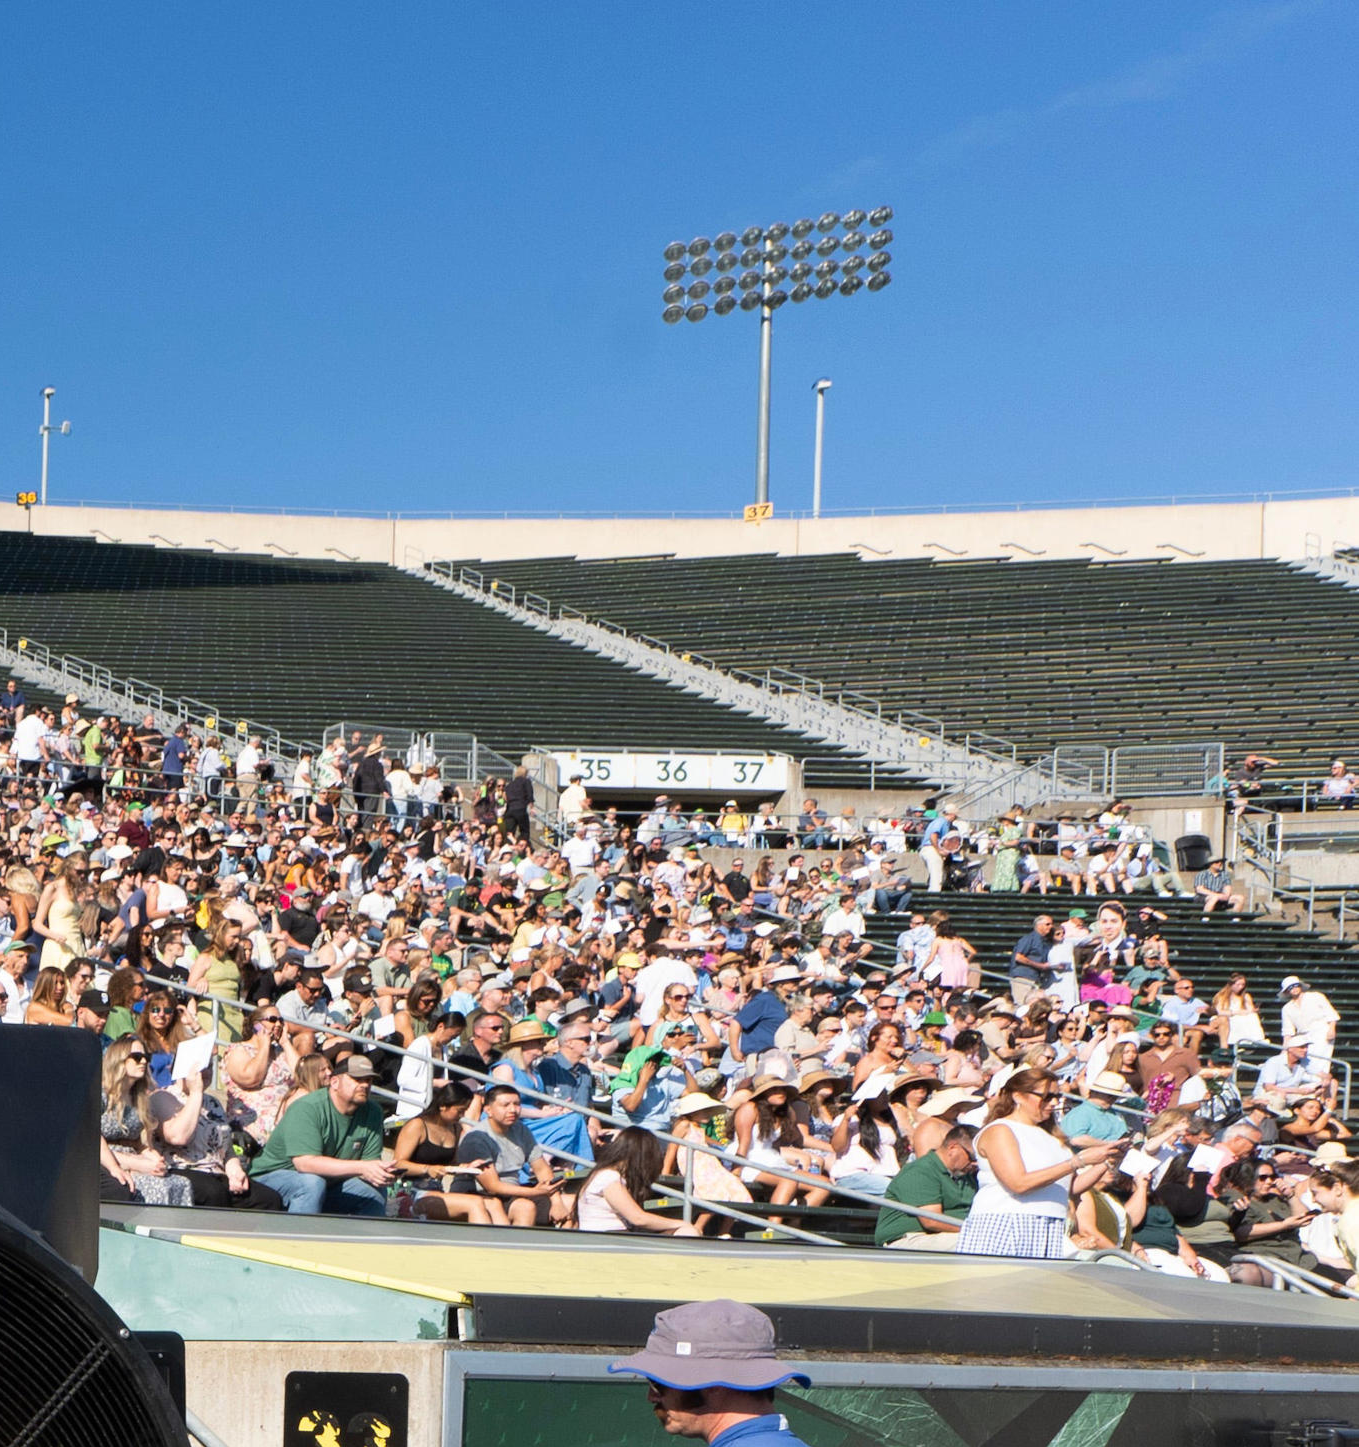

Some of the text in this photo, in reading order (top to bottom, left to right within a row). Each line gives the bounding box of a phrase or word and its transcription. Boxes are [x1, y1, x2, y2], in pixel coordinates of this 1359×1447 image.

[18, 491, 37, 504] 36
[747, 504, 770, 518] 37
[580, 759, 764, 784] 35 36 37
